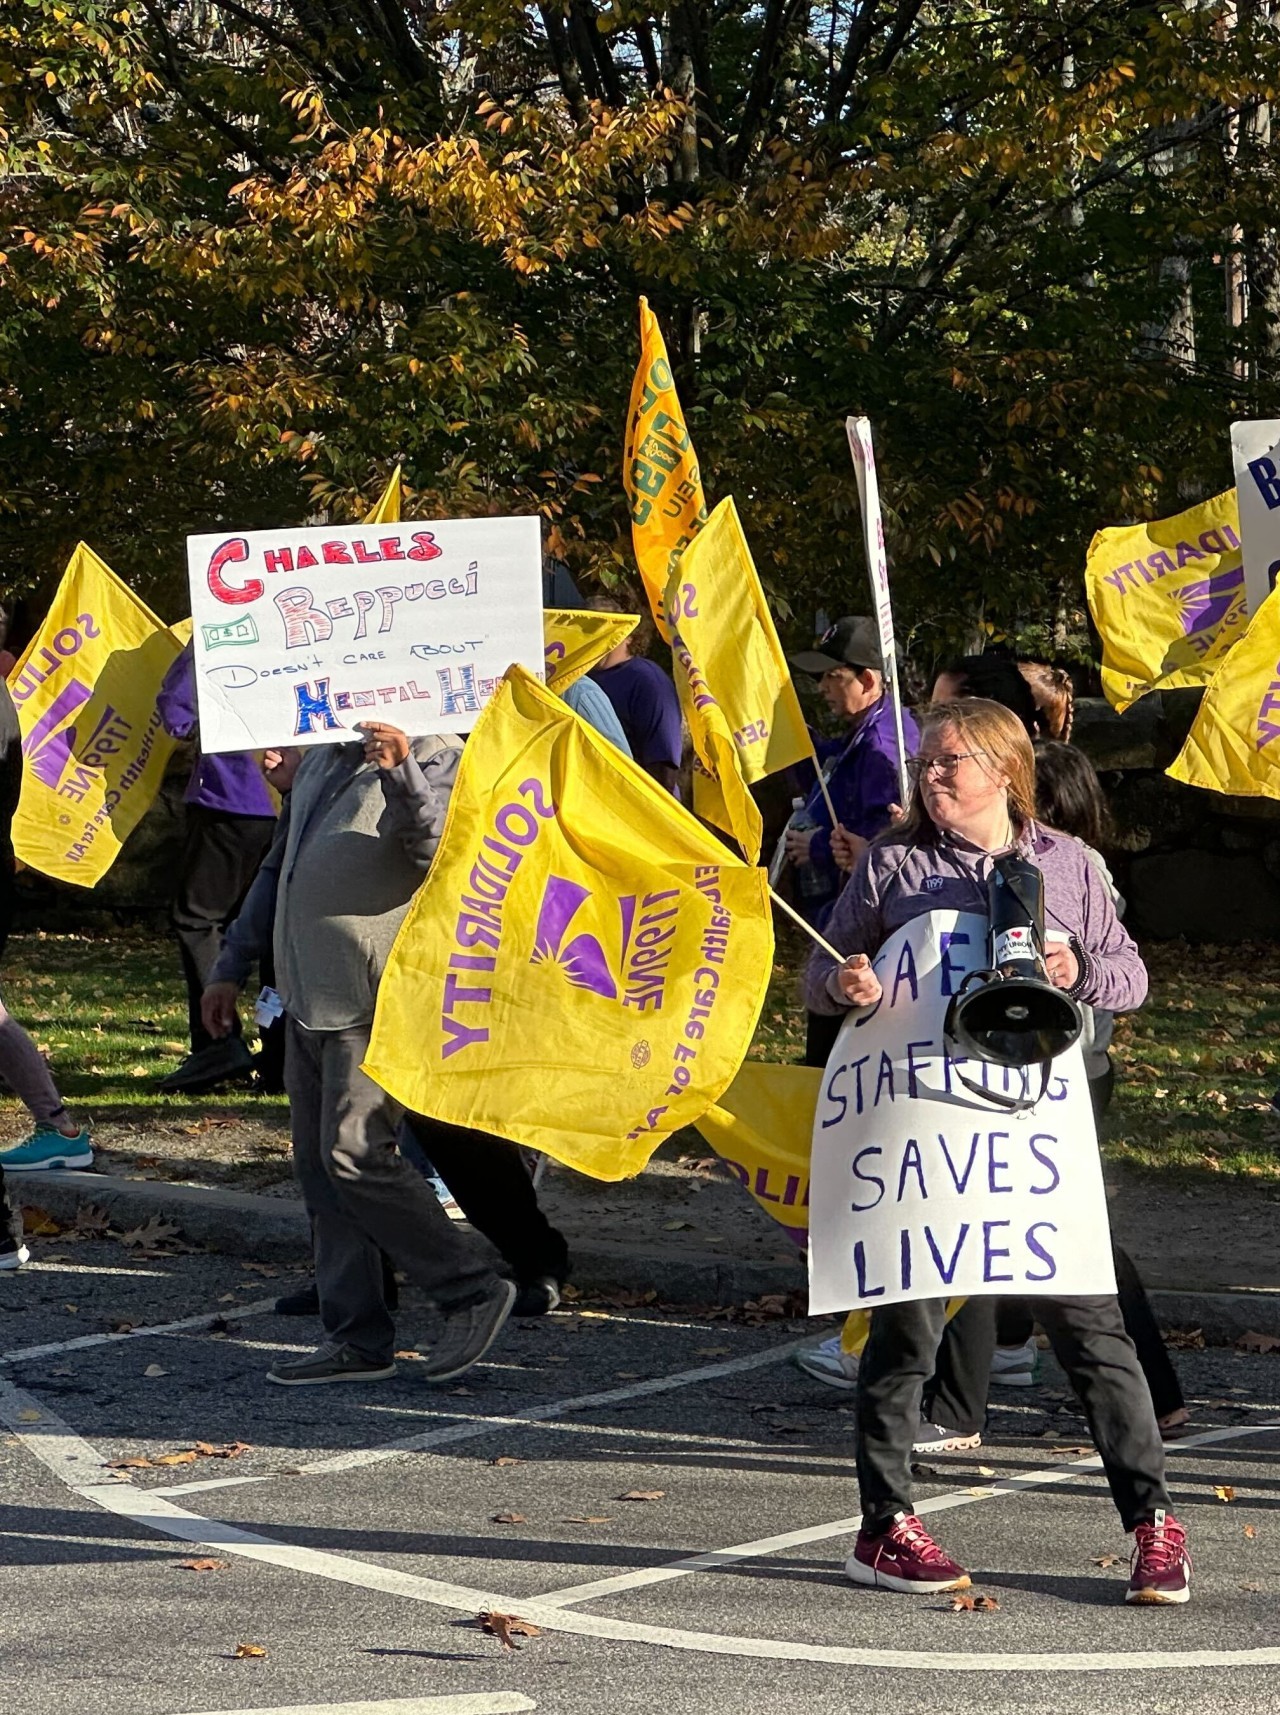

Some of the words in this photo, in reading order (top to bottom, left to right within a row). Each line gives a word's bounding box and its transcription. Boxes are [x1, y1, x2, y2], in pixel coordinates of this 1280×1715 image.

[207, 531, 443, 605] CHARLES
[343, 650, 386, 664] CARE
[294, 677, 431, 736] MENTAL
[925, 878, 943, 889] 1199
[851, 1131, 1060, 1212] SAVES
[853, 1219, 1058, 1299] LIVES
